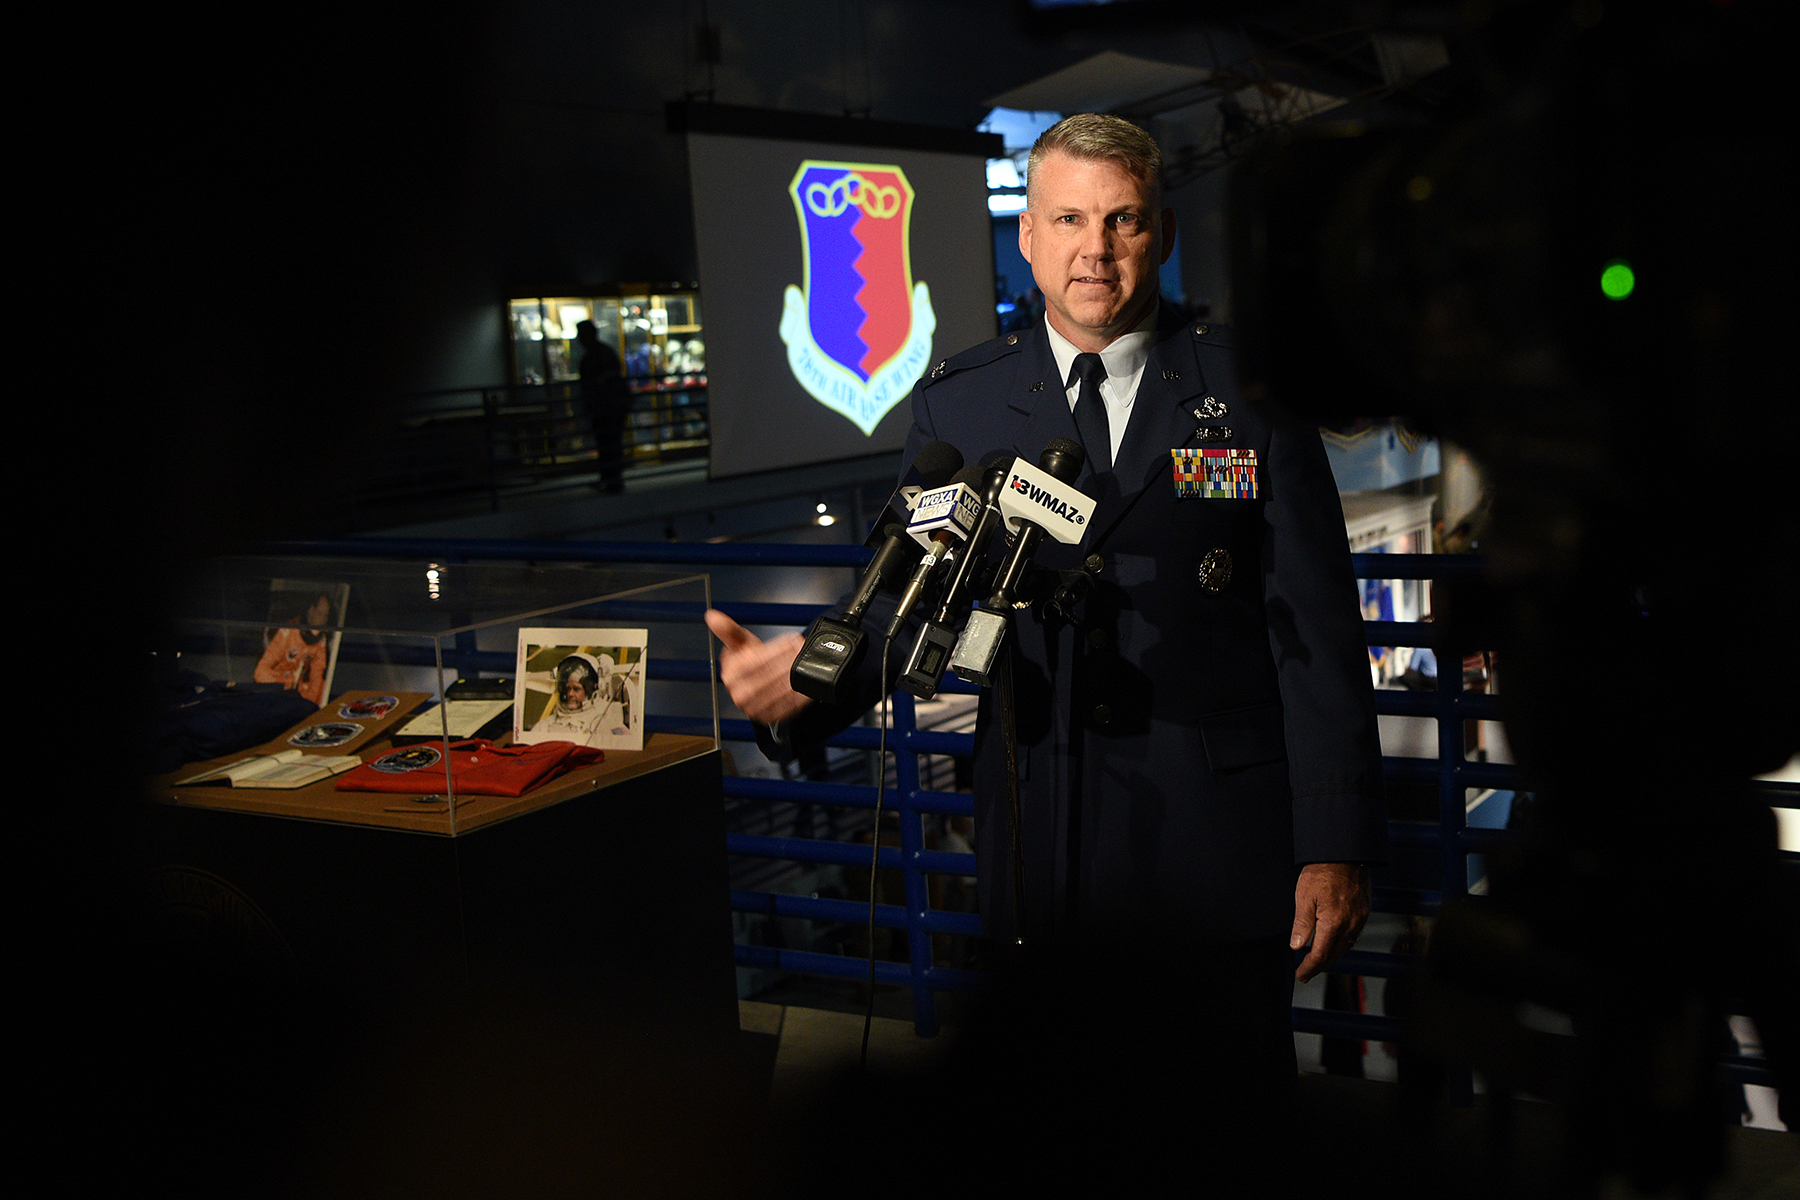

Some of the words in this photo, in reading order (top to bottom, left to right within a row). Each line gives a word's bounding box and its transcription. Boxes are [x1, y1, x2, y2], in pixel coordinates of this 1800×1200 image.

[832, 380, 857, 411] AIR
[891, 341, 926, 387] WING
[921, 490, 954, 508] WGXA
[914, 502, 951, 519] NEWS
